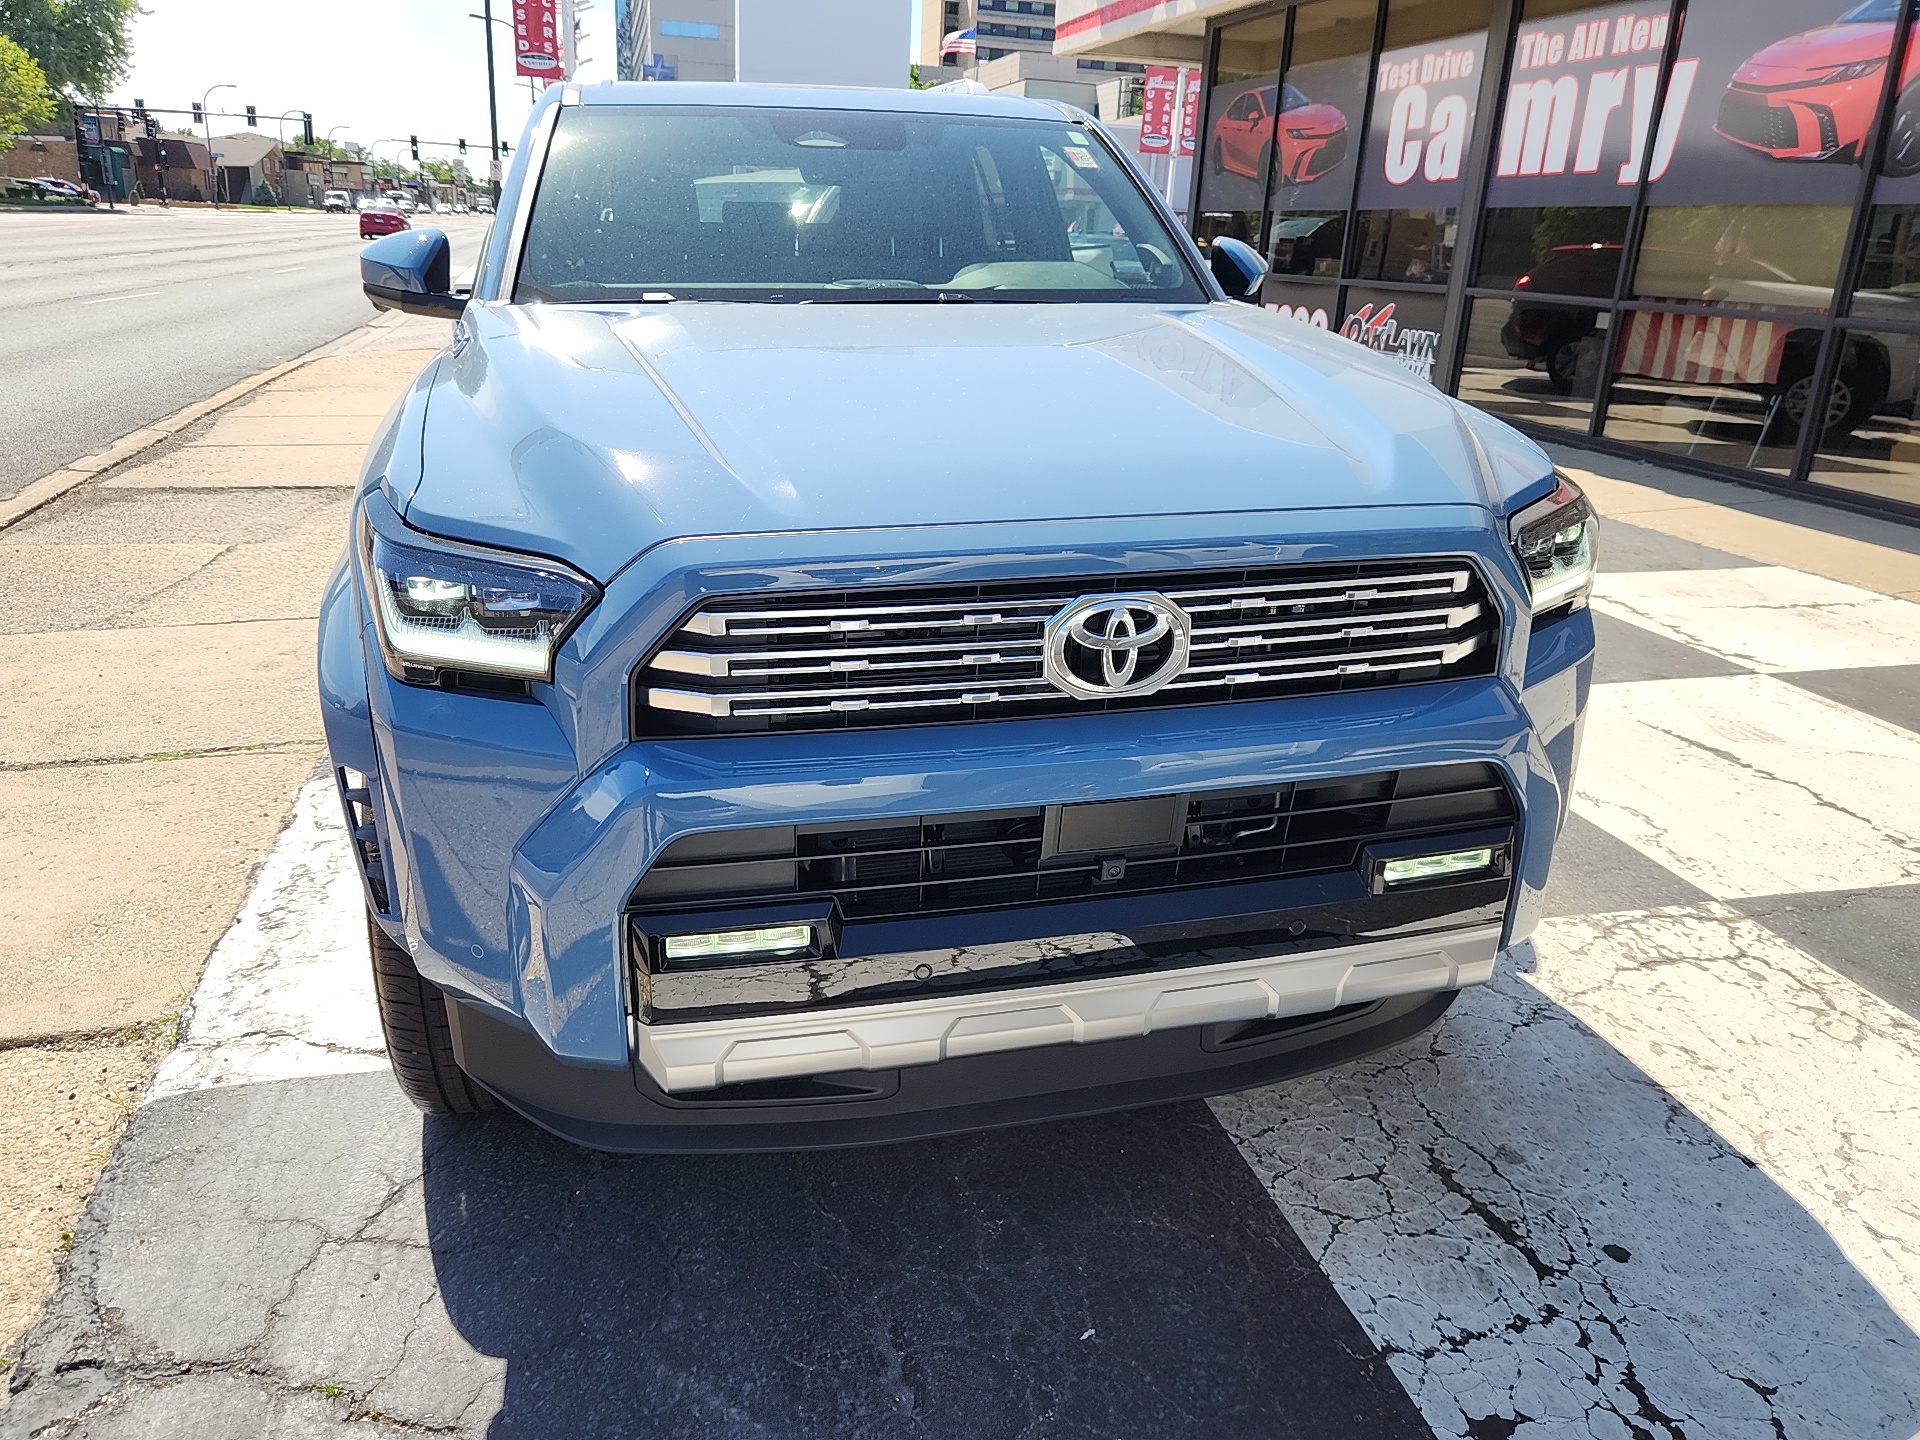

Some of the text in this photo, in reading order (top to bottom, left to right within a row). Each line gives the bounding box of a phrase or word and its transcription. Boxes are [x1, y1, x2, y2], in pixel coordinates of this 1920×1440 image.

[1519, 31, 1564, 70] The
[1566, 18, 1610, 63] All
[1380, 49, 1474, 92] Test Drive
[1143, 89, 1155, 133] USED
[1161, 91, 1172, 135] CARS
[1183, 93, 1196, 137] USED
